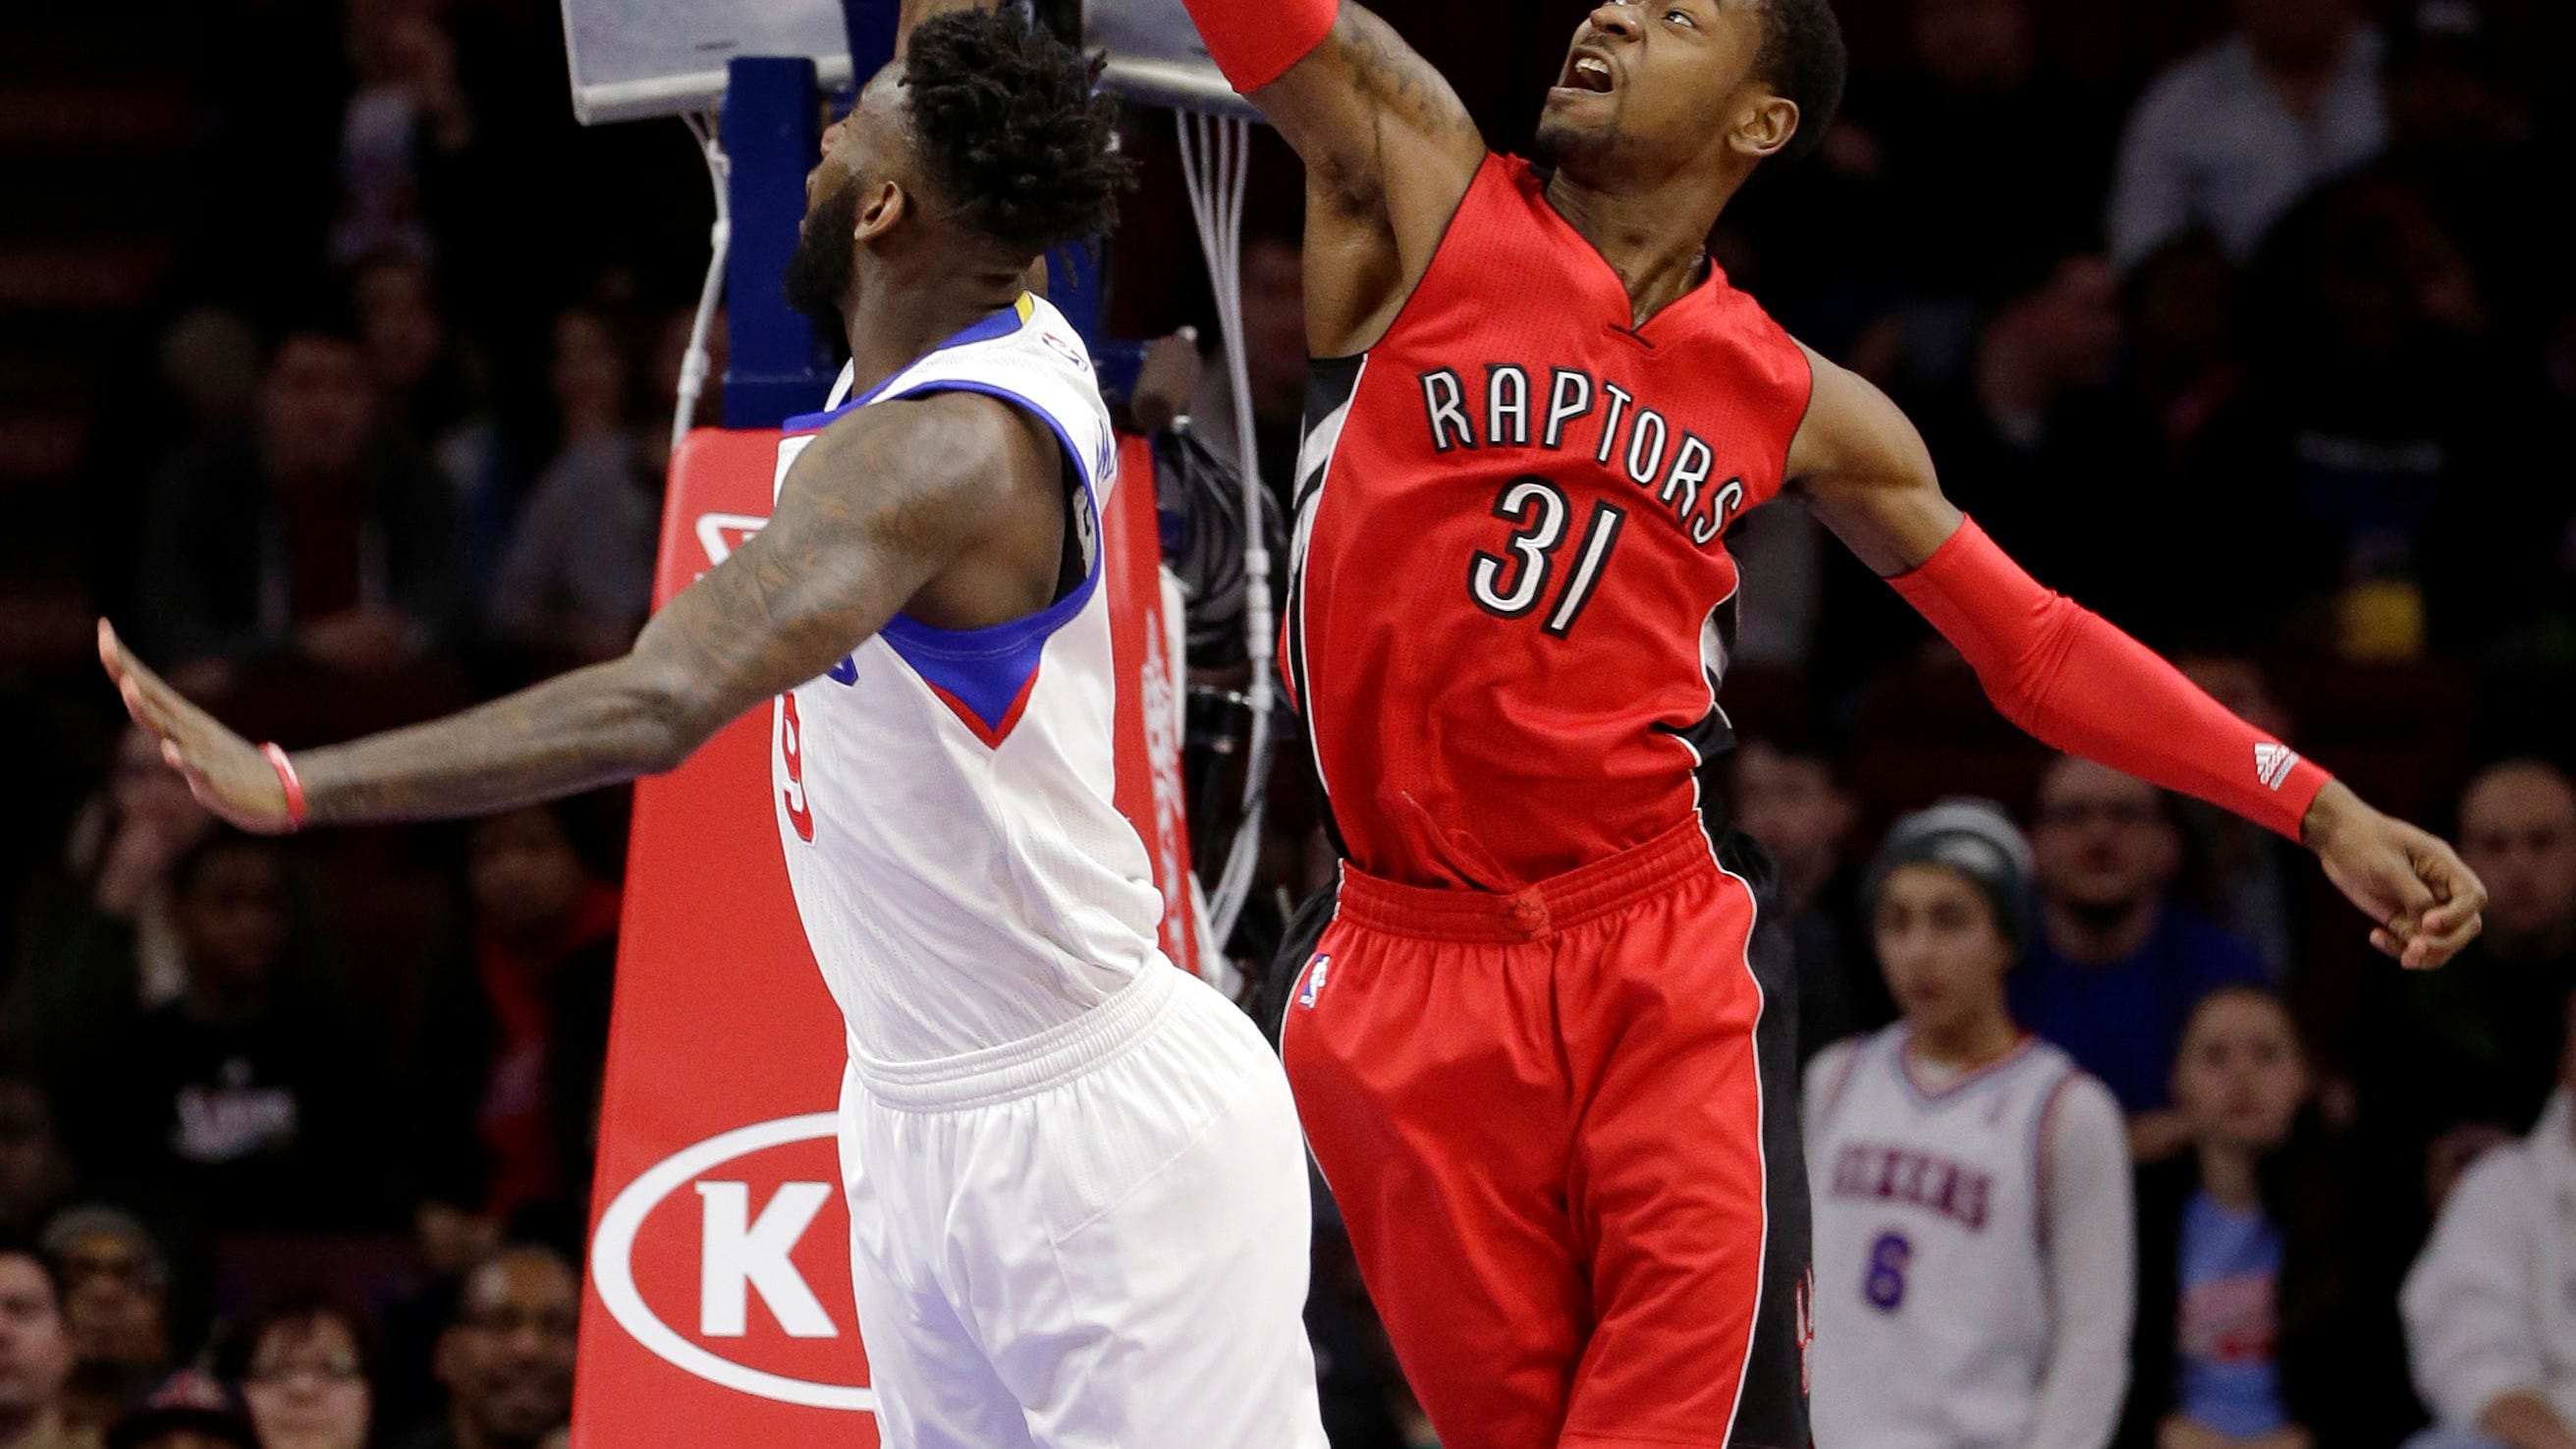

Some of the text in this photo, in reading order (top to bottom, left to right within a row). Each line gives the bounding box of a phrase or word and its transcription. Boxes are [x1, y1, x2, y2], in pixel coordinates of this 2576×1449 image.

[1420, 362, 1746, 546] RAPTORS
[1468, 474, 1626, 639] 31
[1866, 1231, 1912, 1311] 6
